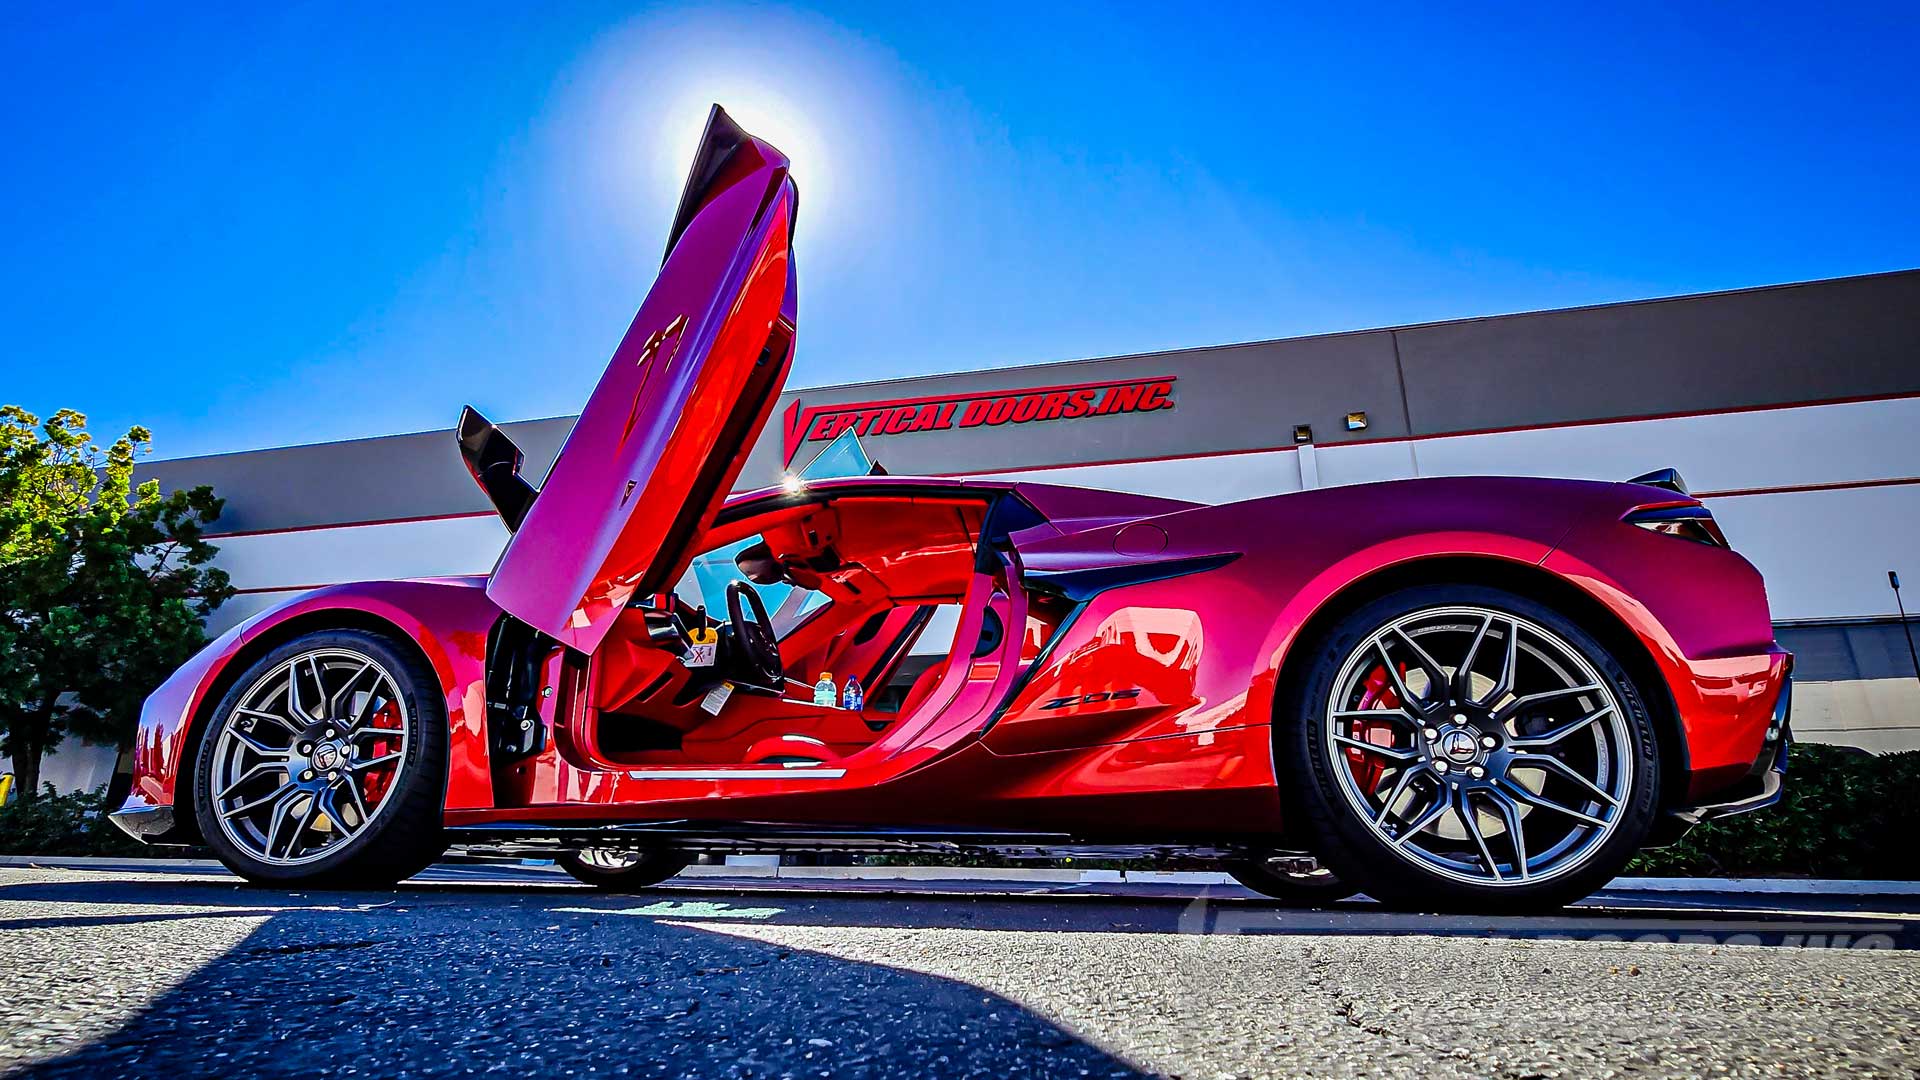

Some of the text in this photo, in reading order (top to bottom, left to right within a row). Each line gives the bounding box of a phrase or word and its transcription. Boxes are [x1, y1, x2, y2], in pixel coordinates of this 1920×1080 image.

[784, 399, 957, 471] VERTICAL
[1038, 689, 1142, 710] Z06
[1618, 681, 1653, 757] MICHELIN
[408, 707, 418, 763] MICHELIN
[198, 743, 210, 798] MICHELIN
